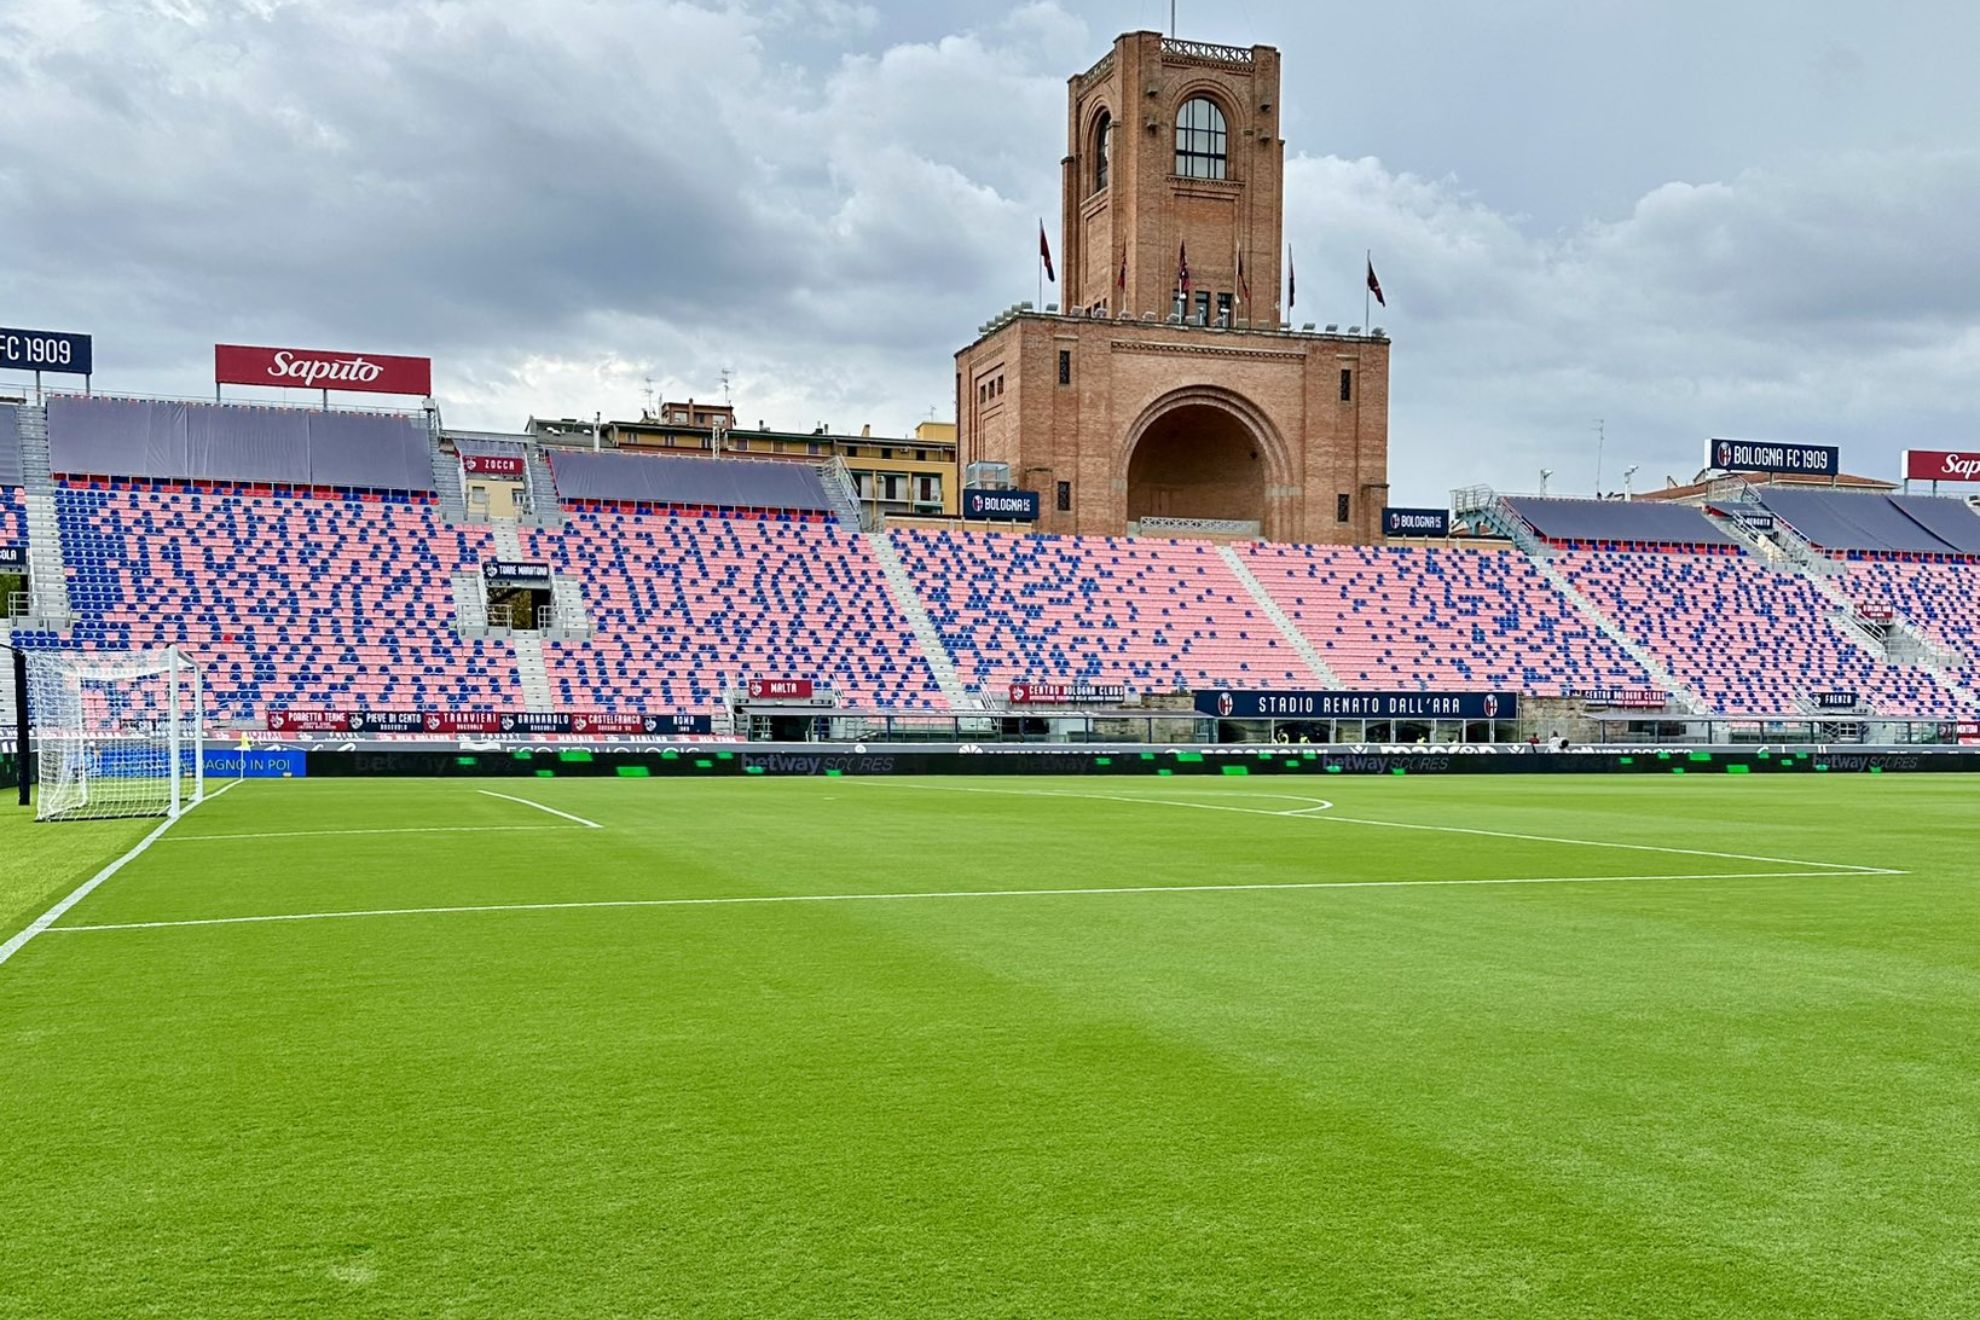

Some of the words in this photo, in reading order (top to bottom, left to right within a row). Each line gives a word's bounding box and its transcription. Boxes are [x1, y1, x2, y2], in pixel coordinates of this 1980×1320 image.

[24, 337, 71, 364] 1909
[267, 351, 384, 386] Saputo
[1734, 445, 1784, 467] BOLOGNA
[1787, 449, 1800, 468] FC
[1802, 449, 1828, 470] 1909
[485, 459, 515, 471] ZOCCA
[984, 497, 1023, 512] BOLOGNA
[1400, 514, 1435, 529] BOLOGNA
[770, 682, 798, 694] MALTA
[1029, 685, 1060, 696] CENTRO
[1063, 685, 1096, 696] BOLOGNA
[1099, 685, 1124, 696] CLUBS
[1258, 696, 1314, 714] STADIO
[1323, 696, 1380, 714] RENATO
[1389, 696, 1460, 714] DALL'ARA
[288, 711, 323, 722] PORRETTA
[324, 712, 345, 722] TERME
[366, 712, 387, 724] PIEVE
[388, 713, 397, 724] DI
[398, 713, 421, 724] CENTO
[444, 712, 496, 723] TRANVIERI
[518, 714, 569, 725] GRANAROLO
[588, 714, 641, 725] CASTELFRANCO
[672, 715, 695, 726] ROMA
[250, 759, 264, 771] IN
[740, 753, 820, 774] betway
[1322, 754, 1389, 774] betway
